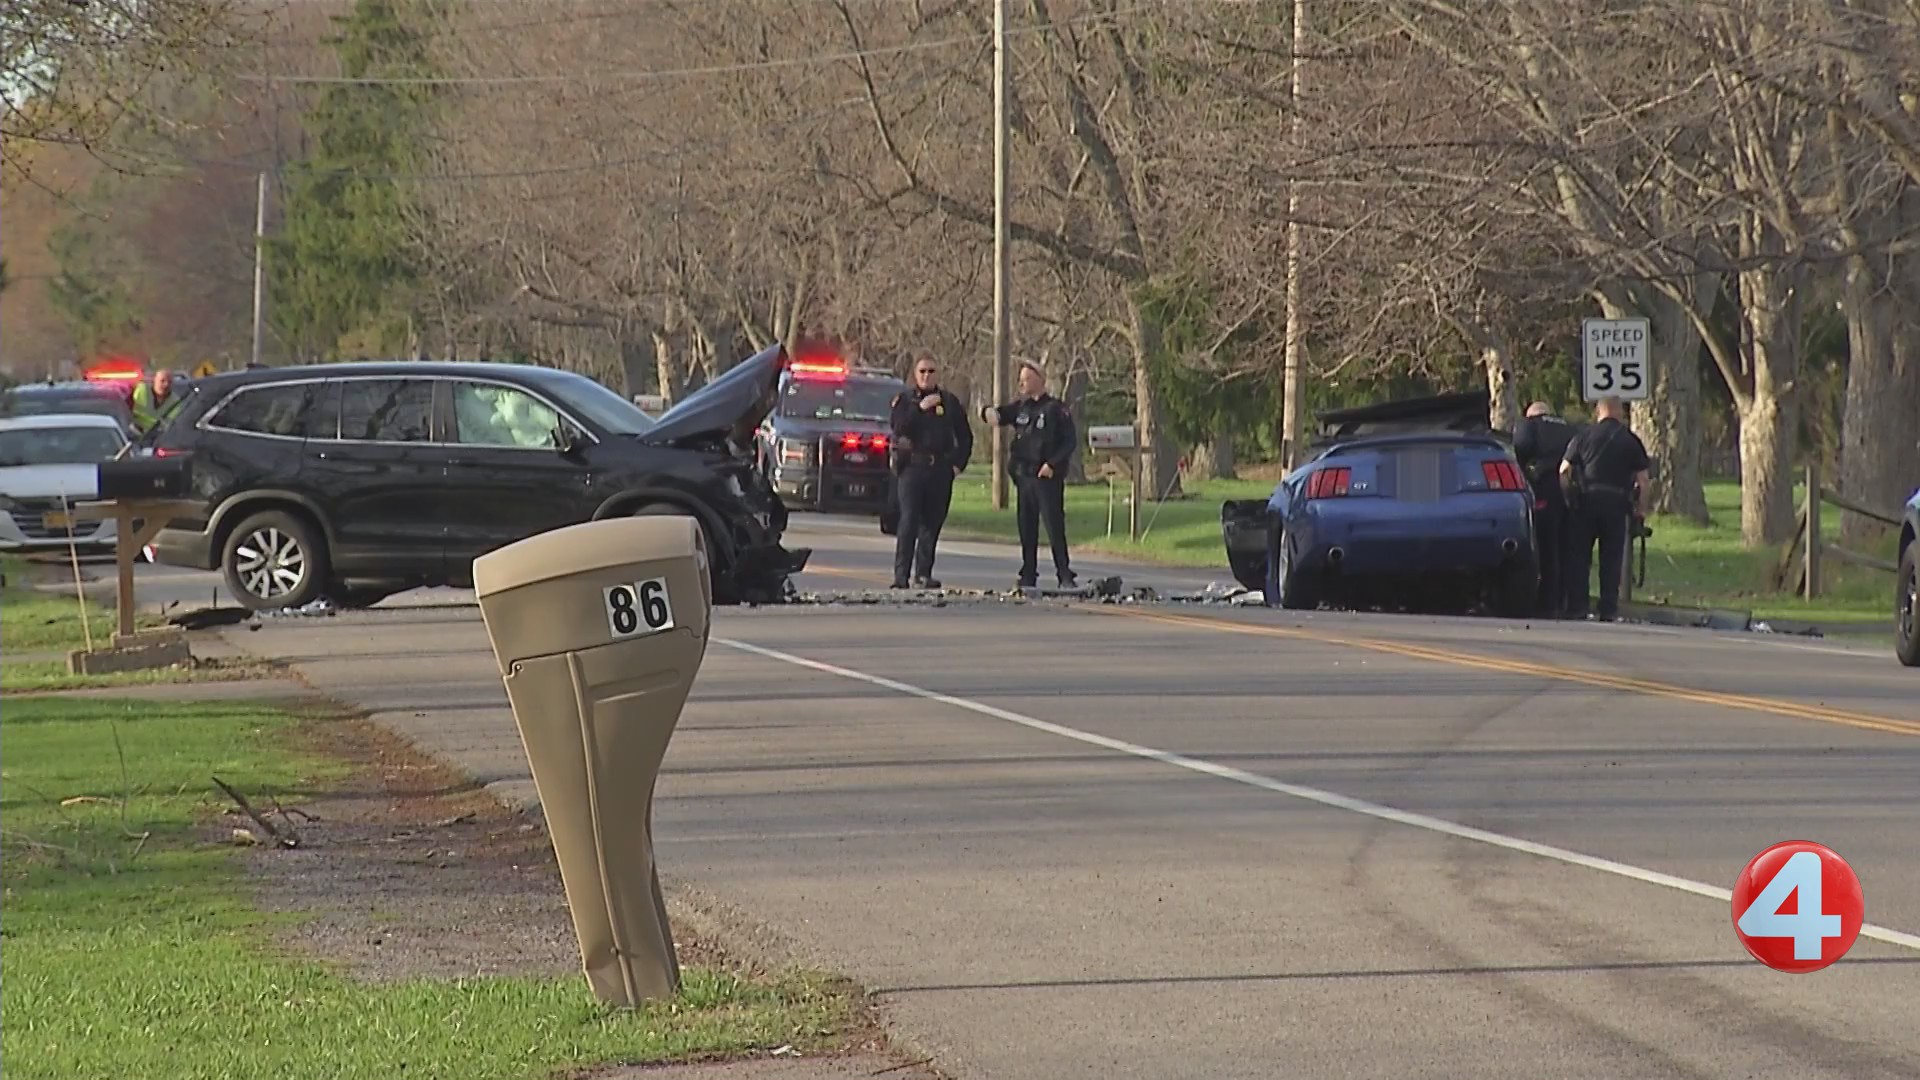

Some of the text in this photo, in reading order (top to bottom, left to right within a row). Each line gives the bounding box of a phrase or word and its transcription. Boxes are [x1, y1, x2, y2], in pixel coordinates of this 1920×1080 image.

[1591, 329, 1643, 341] SPEED
[1596, 346, 1636, 358] LIMIT
[1593, 363, 1641, 390] 35
[609, 581, 668, 633] 86
